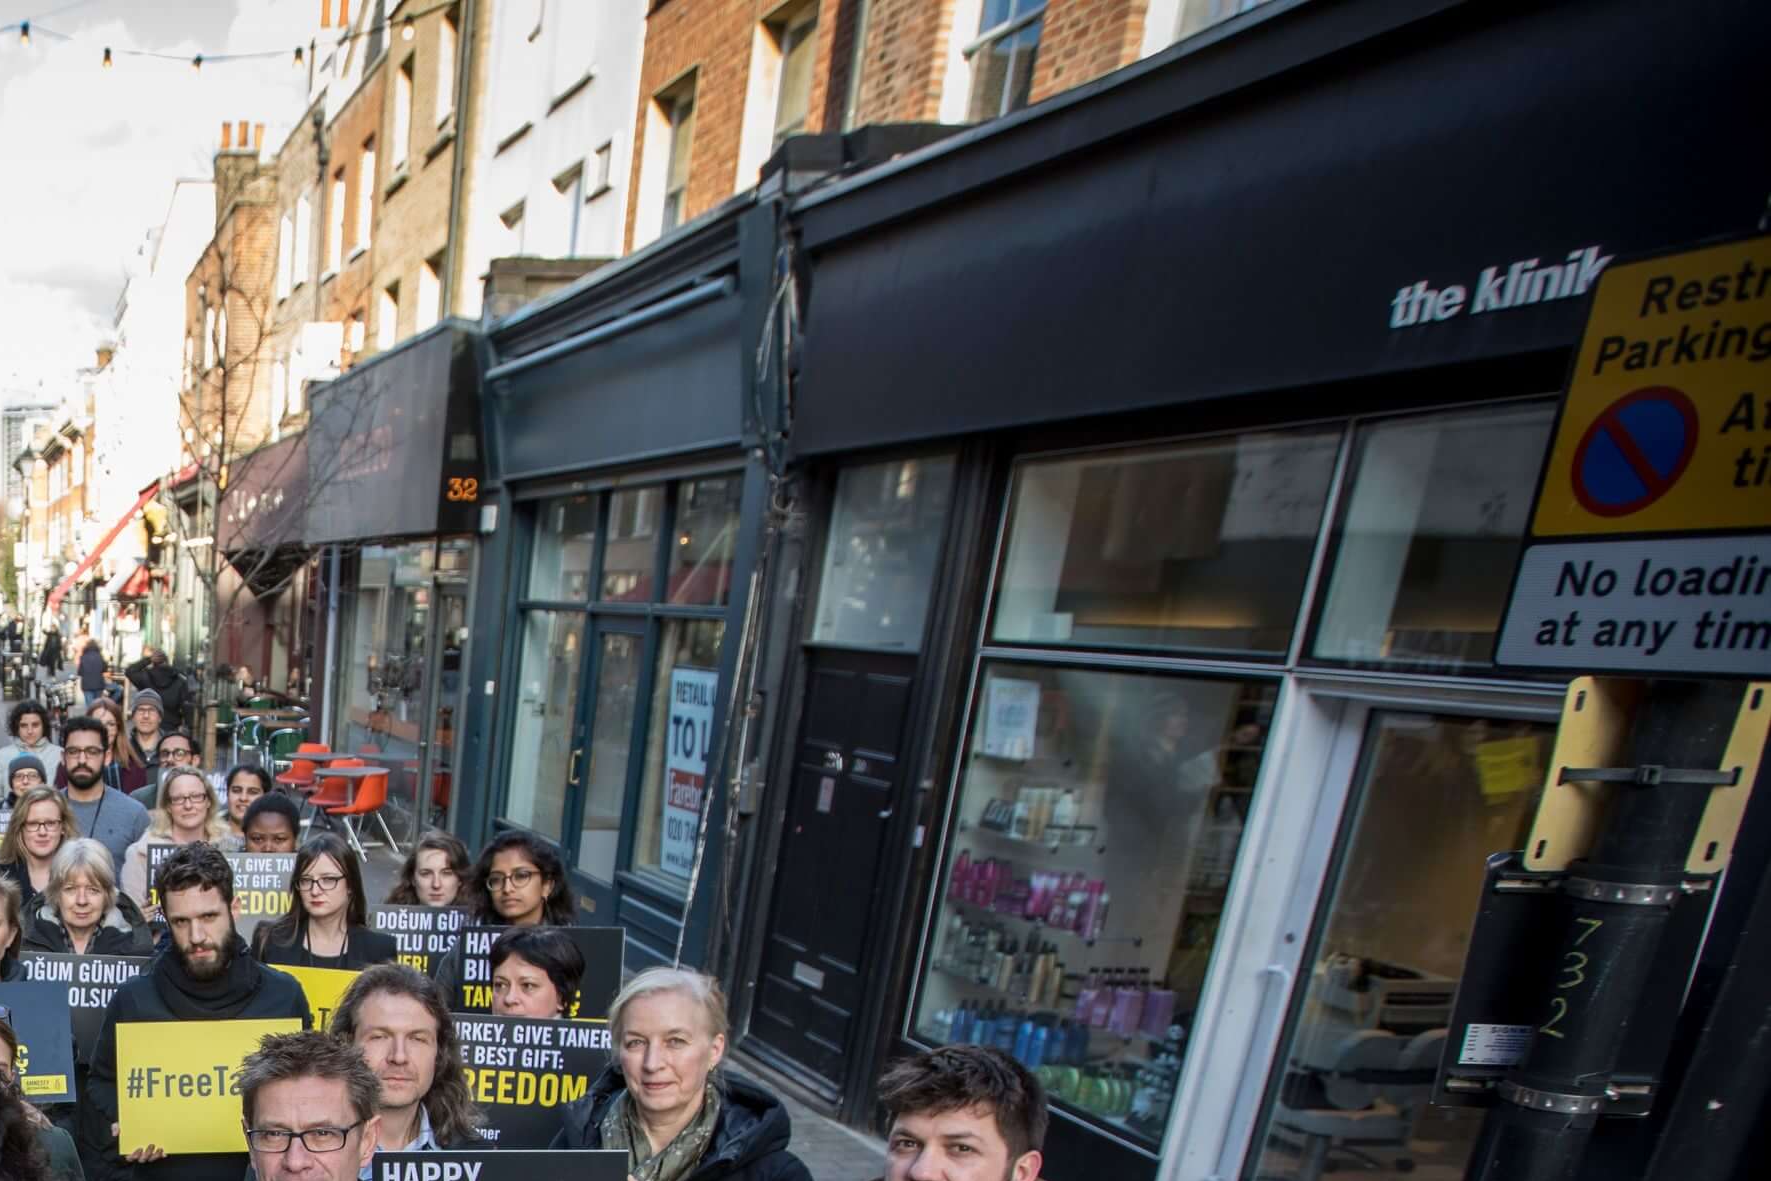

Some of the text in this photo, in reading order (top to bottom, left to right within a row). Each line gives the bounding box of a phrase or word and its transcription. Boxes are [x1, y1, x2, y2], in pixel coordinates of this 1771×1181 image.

[1389, 246, 1616, 329] the klinik
[1639, 260, 1771, 318] Restr
[446, 477, 479, 501] 32
[1554, 560, 1617, 597] No
[1535, 609, 1771, 656] at any tim
[673, 716, 696, 759] TO
[245, 858, 272, 873] GIVE
[277, 858, 295, 873] TAN
[252, 875, 281, 888] GIFT:
[239, 890, 292, 915] EDOM
[376, 911, 432, 931] DOĞUM
[23, 956, 73, 982] OĞUM
[513, 1025, 553, 1045] GIVE
[558, 1027, 612, 1049] TANER
[474, 1045, 517, 1067] BEST
[521, 1048, 564, 1069] GIFT:
[127, 1065, 243, 1098] #FreeTa
[462, 1068, 588, 1108] REEDOM
